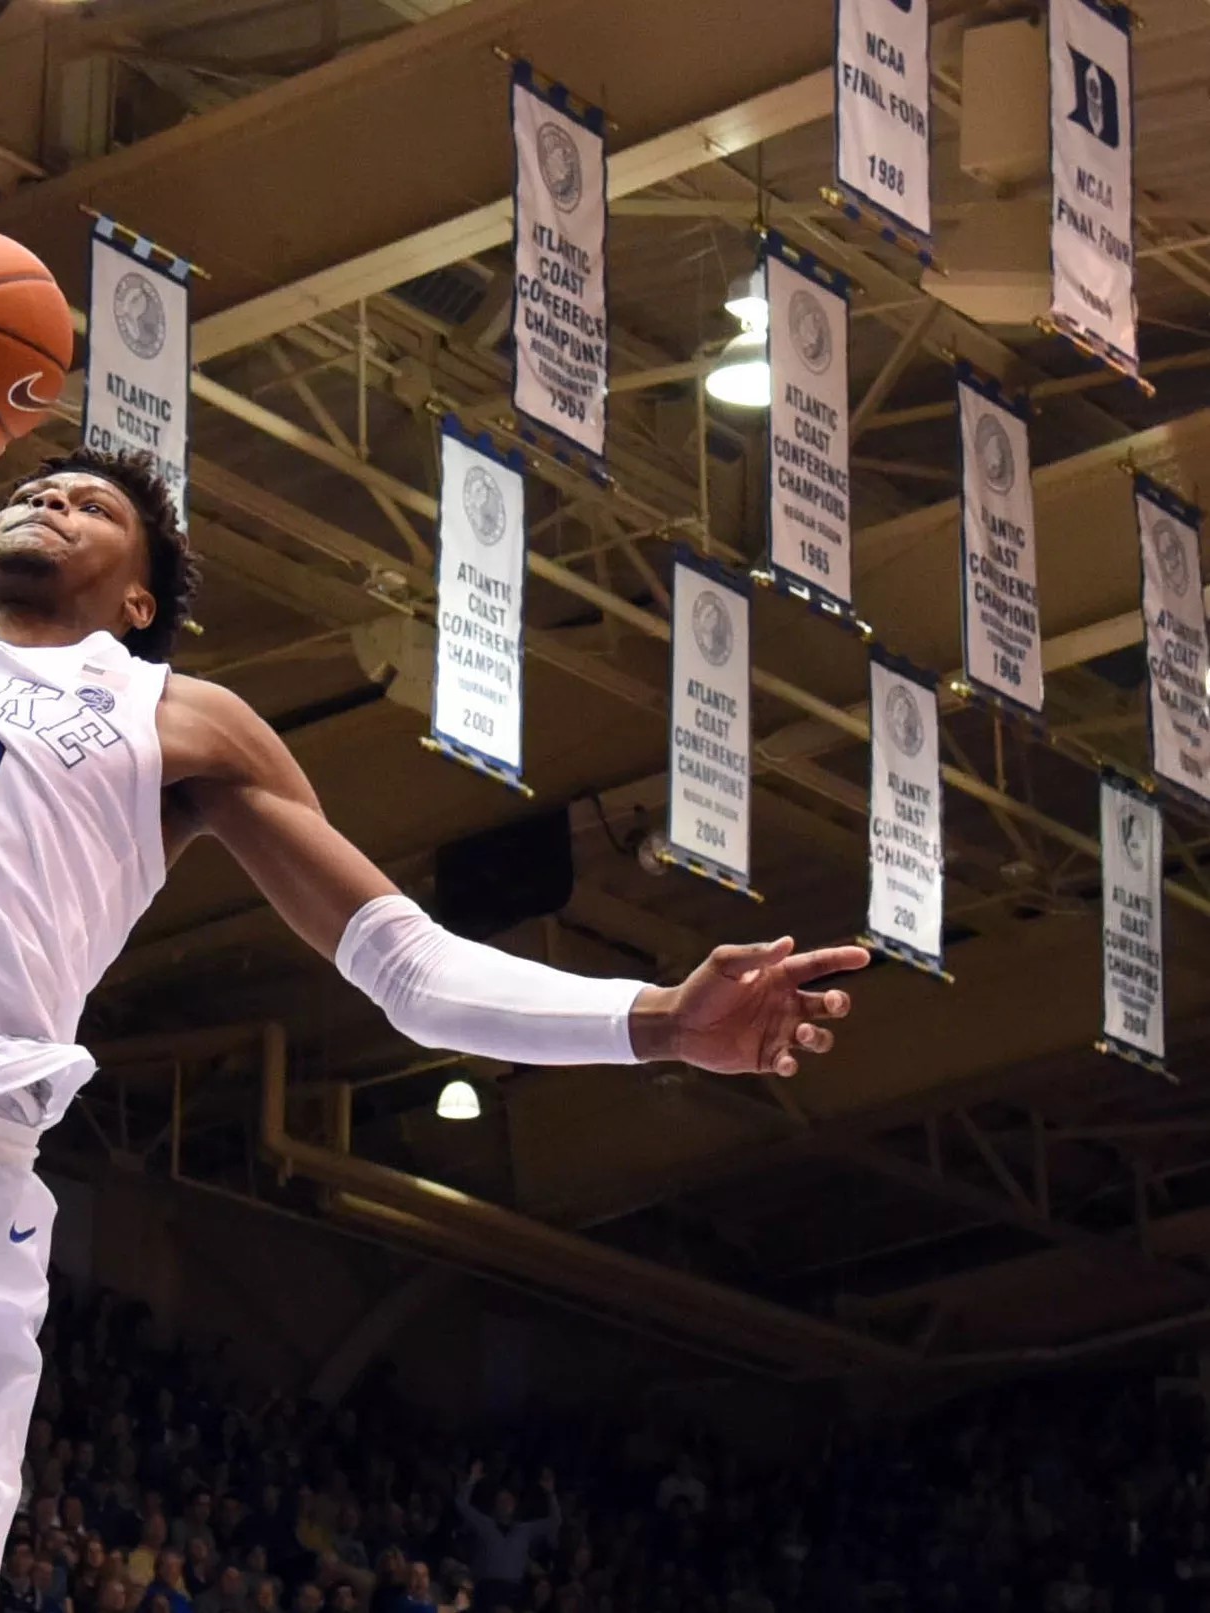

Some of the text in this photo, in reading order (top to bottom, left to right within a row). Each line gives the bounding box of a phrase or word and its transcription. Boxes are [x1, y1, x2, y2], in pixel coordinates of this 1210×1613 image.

[866, 32, 906, 78] NCAA
[842, 64, 926, 137] FINAL FOUR
[867, 154, 905, 196] 1988
[1076, 166, 1113, 211] NCAA
[539, 256, 586, 299] COAST
[107, 373, 172, 422] ATLANTIC
[785, 383, 838, 432] ATLANTIC
[117, 406, 160, 446] COAST
[795, 416, 831, 455] COAST
[773, 434, 848, 495] CONFERENCE
[778, 466, 846, 522] CHAMPIONS
[457, 561, 512, 606] ATLANTIC
[468, 593, 506, 628] COAST
[687, 679, 737, 719] ATLANTIC
[695, 708, 730, 739] COAST
[675, 725, 746, 776] CONFERENCE
[678, 753, 743, 800] CHAMPIONS
[694, 818, 726, 849] 2004
[895, 798, 926, 828] COAST
